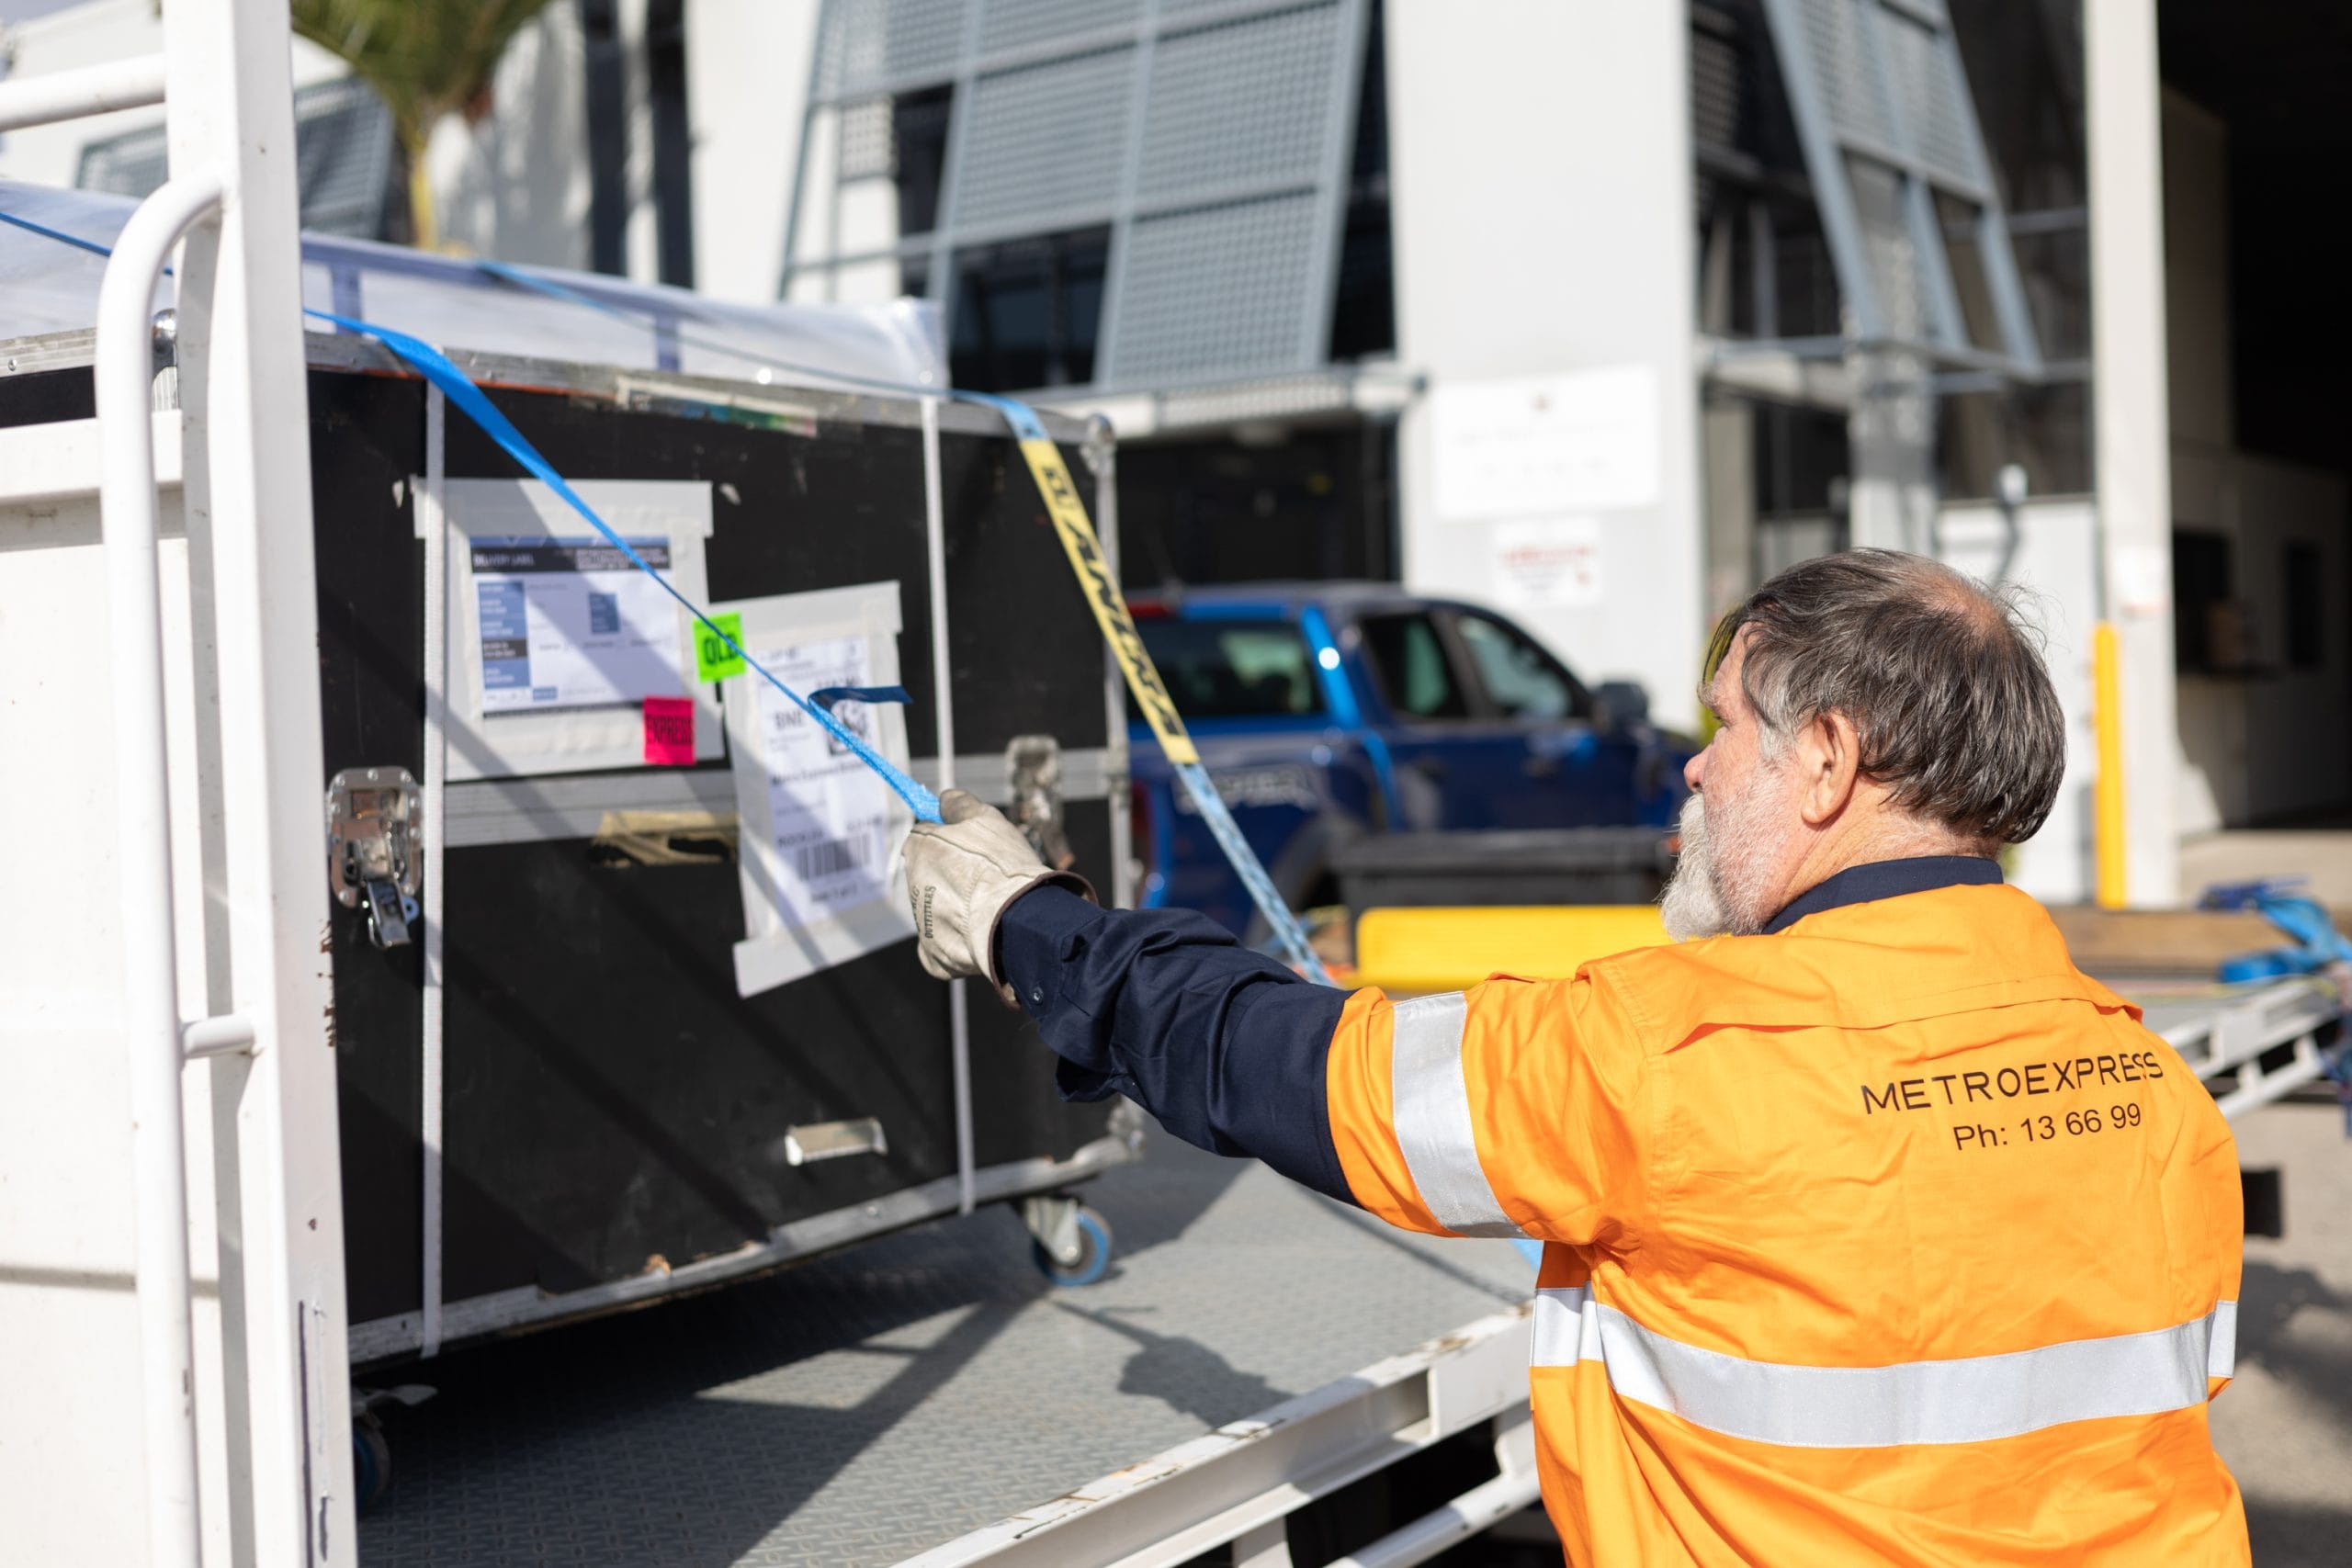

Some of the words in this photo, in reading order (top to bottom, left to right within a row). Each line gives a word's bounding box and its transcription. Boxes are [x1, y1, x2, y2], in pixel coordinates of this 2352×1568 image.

[924, 885, 937, 939] OUTFITTERS
[1860, 1052, 2164, 1114] METROEXPRESS
[1952, 1124, 2008, 1151] Ph:
[2020, 1115, 2056, 1142] 13
[2066, 1109, 2102, 1135] 66
[2110, 1102, 2142, 1130] 99
